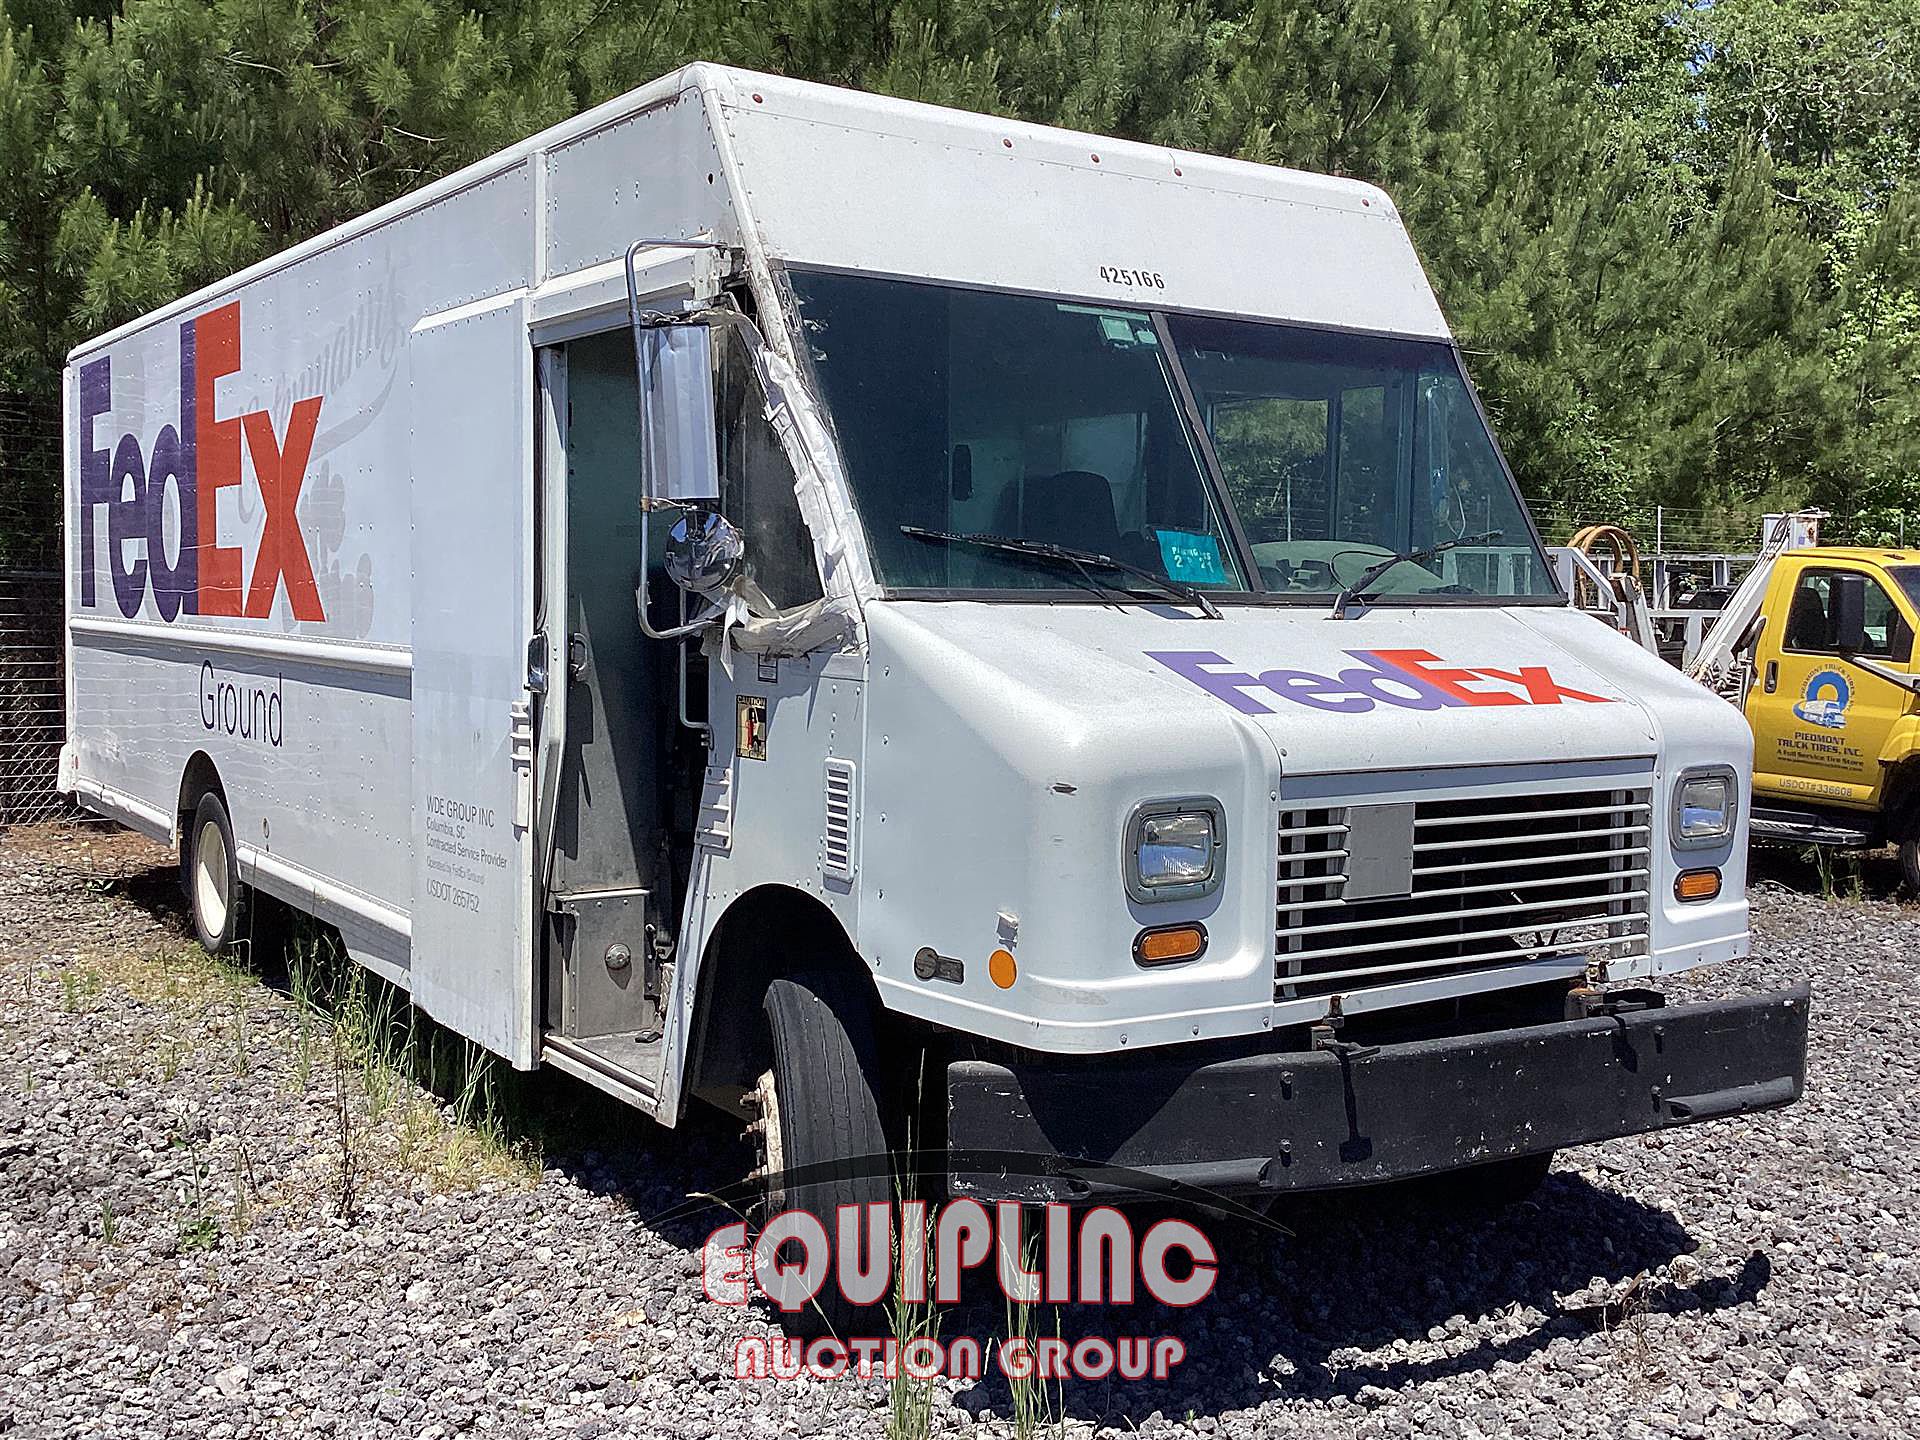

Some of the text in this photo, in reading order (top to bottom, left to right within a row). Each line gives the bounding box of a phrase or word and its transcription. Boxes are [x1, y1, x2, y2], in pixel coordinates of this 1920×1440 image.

[1100, 266, 1165, 289] 425166
[79, 299, 327, 623] FedEx
[1142, 648, 1618, 715] FedEx
[200, 659, 283, 747] Ground
[737, 695, 766, 706] CAUTION
[1777, 738, 1863, 757] TRUCK TIRES, INC.
[1794, 732, 1845, 745] PIEDMONT
[1779, 778, 1852, 797] USDOT#336608
[426, 794, 494, 828] WDE GROUP INC
[456, 825, 466, 840] SC
[426, 833, 507, 868] Contracted Service Provider
[426, 877, 480, 913] USDOT 265752
